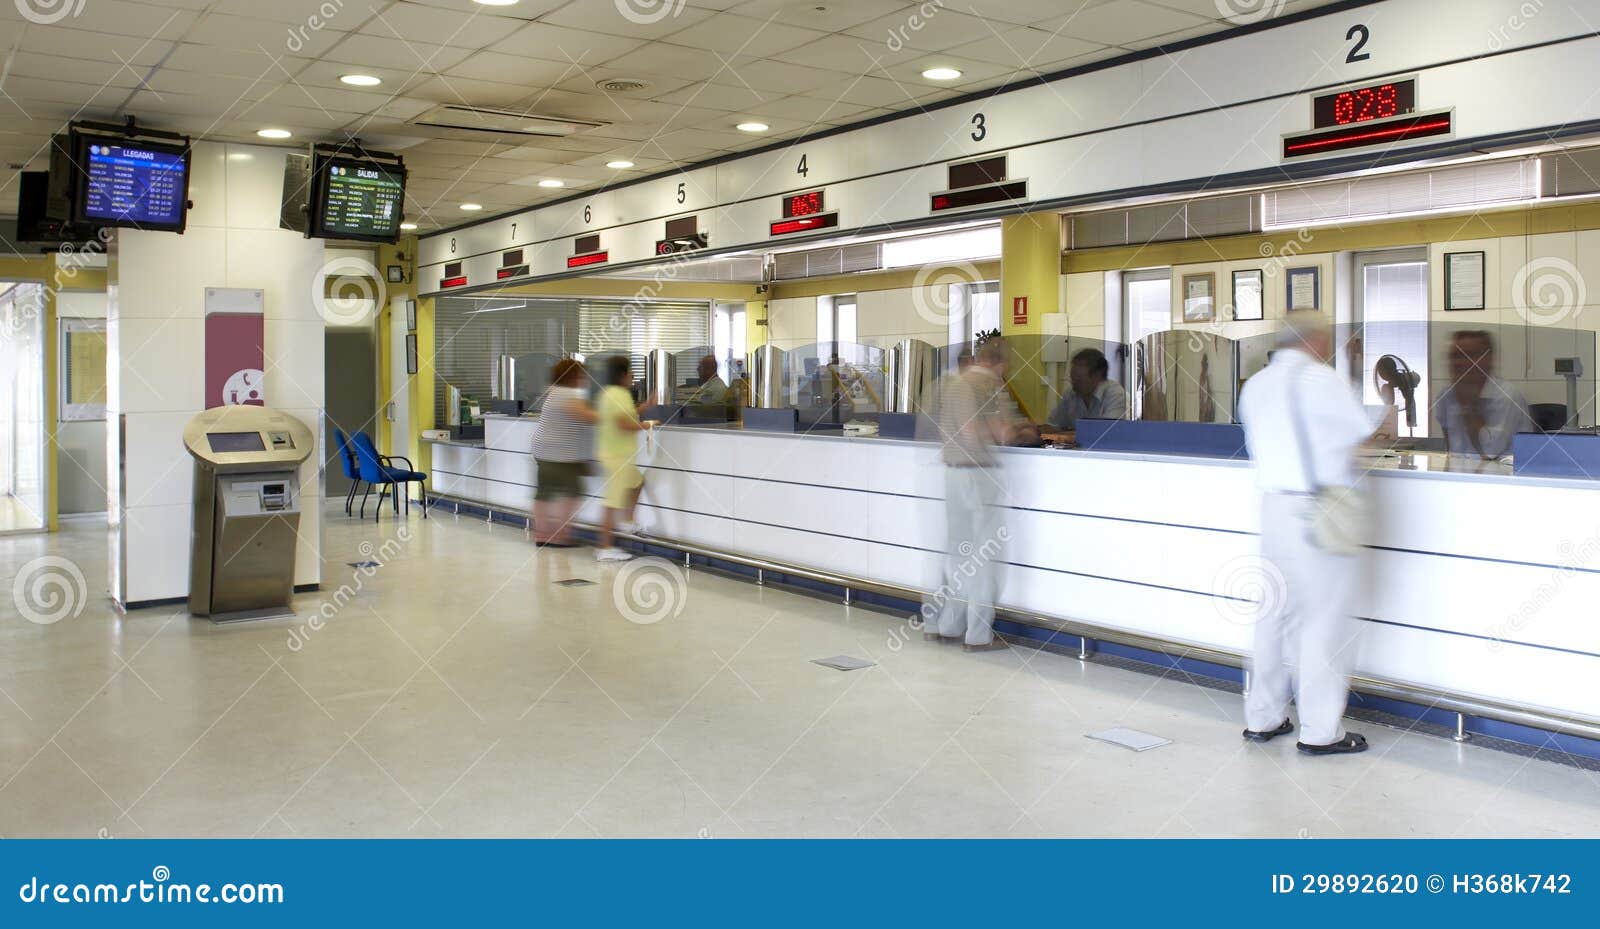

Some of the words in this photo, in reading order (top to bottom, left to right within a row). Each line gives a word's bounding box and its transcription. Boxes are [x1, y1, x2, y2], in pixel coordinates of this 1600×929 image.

[1345, 24, 1370, 64] 2
[1335, 84, 1396, 125] 028
[971, 113, 986, 142] 3
[123, 150, 154, 160] LLEGADAS
[357, 170, 378, 179] SALIDAS
[797, 153, 808, 178] 4
[677, 182, 686, 204] 5
[584, 205, 592, 223] 6
[511, 223, 518, 240] 7
[450, 237, 457, 253] 8
